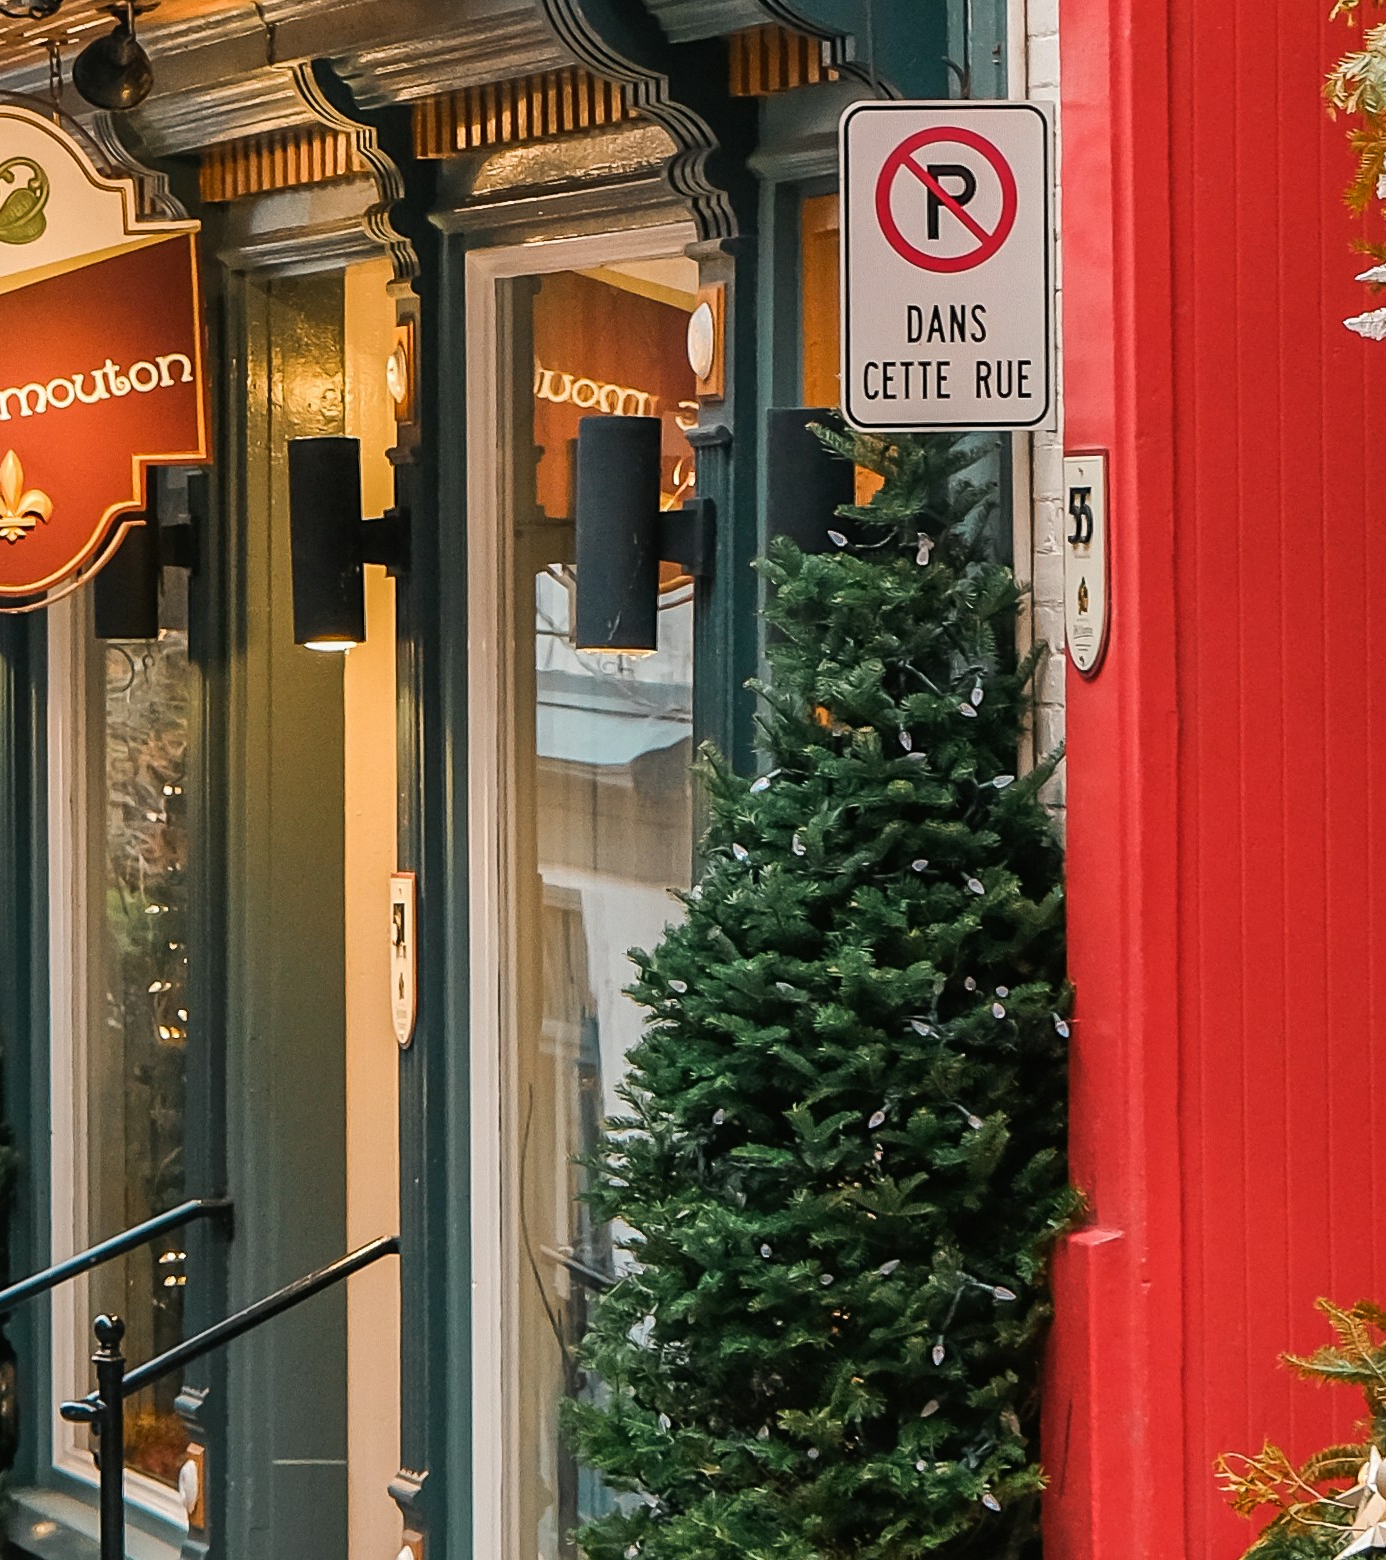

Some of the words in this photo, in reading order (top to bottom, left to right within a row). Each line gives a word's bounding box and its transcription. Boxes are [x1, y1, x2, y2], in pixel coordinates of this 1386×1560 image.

[906, 303, 988, 344] DANS
[862, 360, 952, 401] CETTE
[975, 358, 1034, 400] RUE
[1067, 486, 1095, 545] 55
